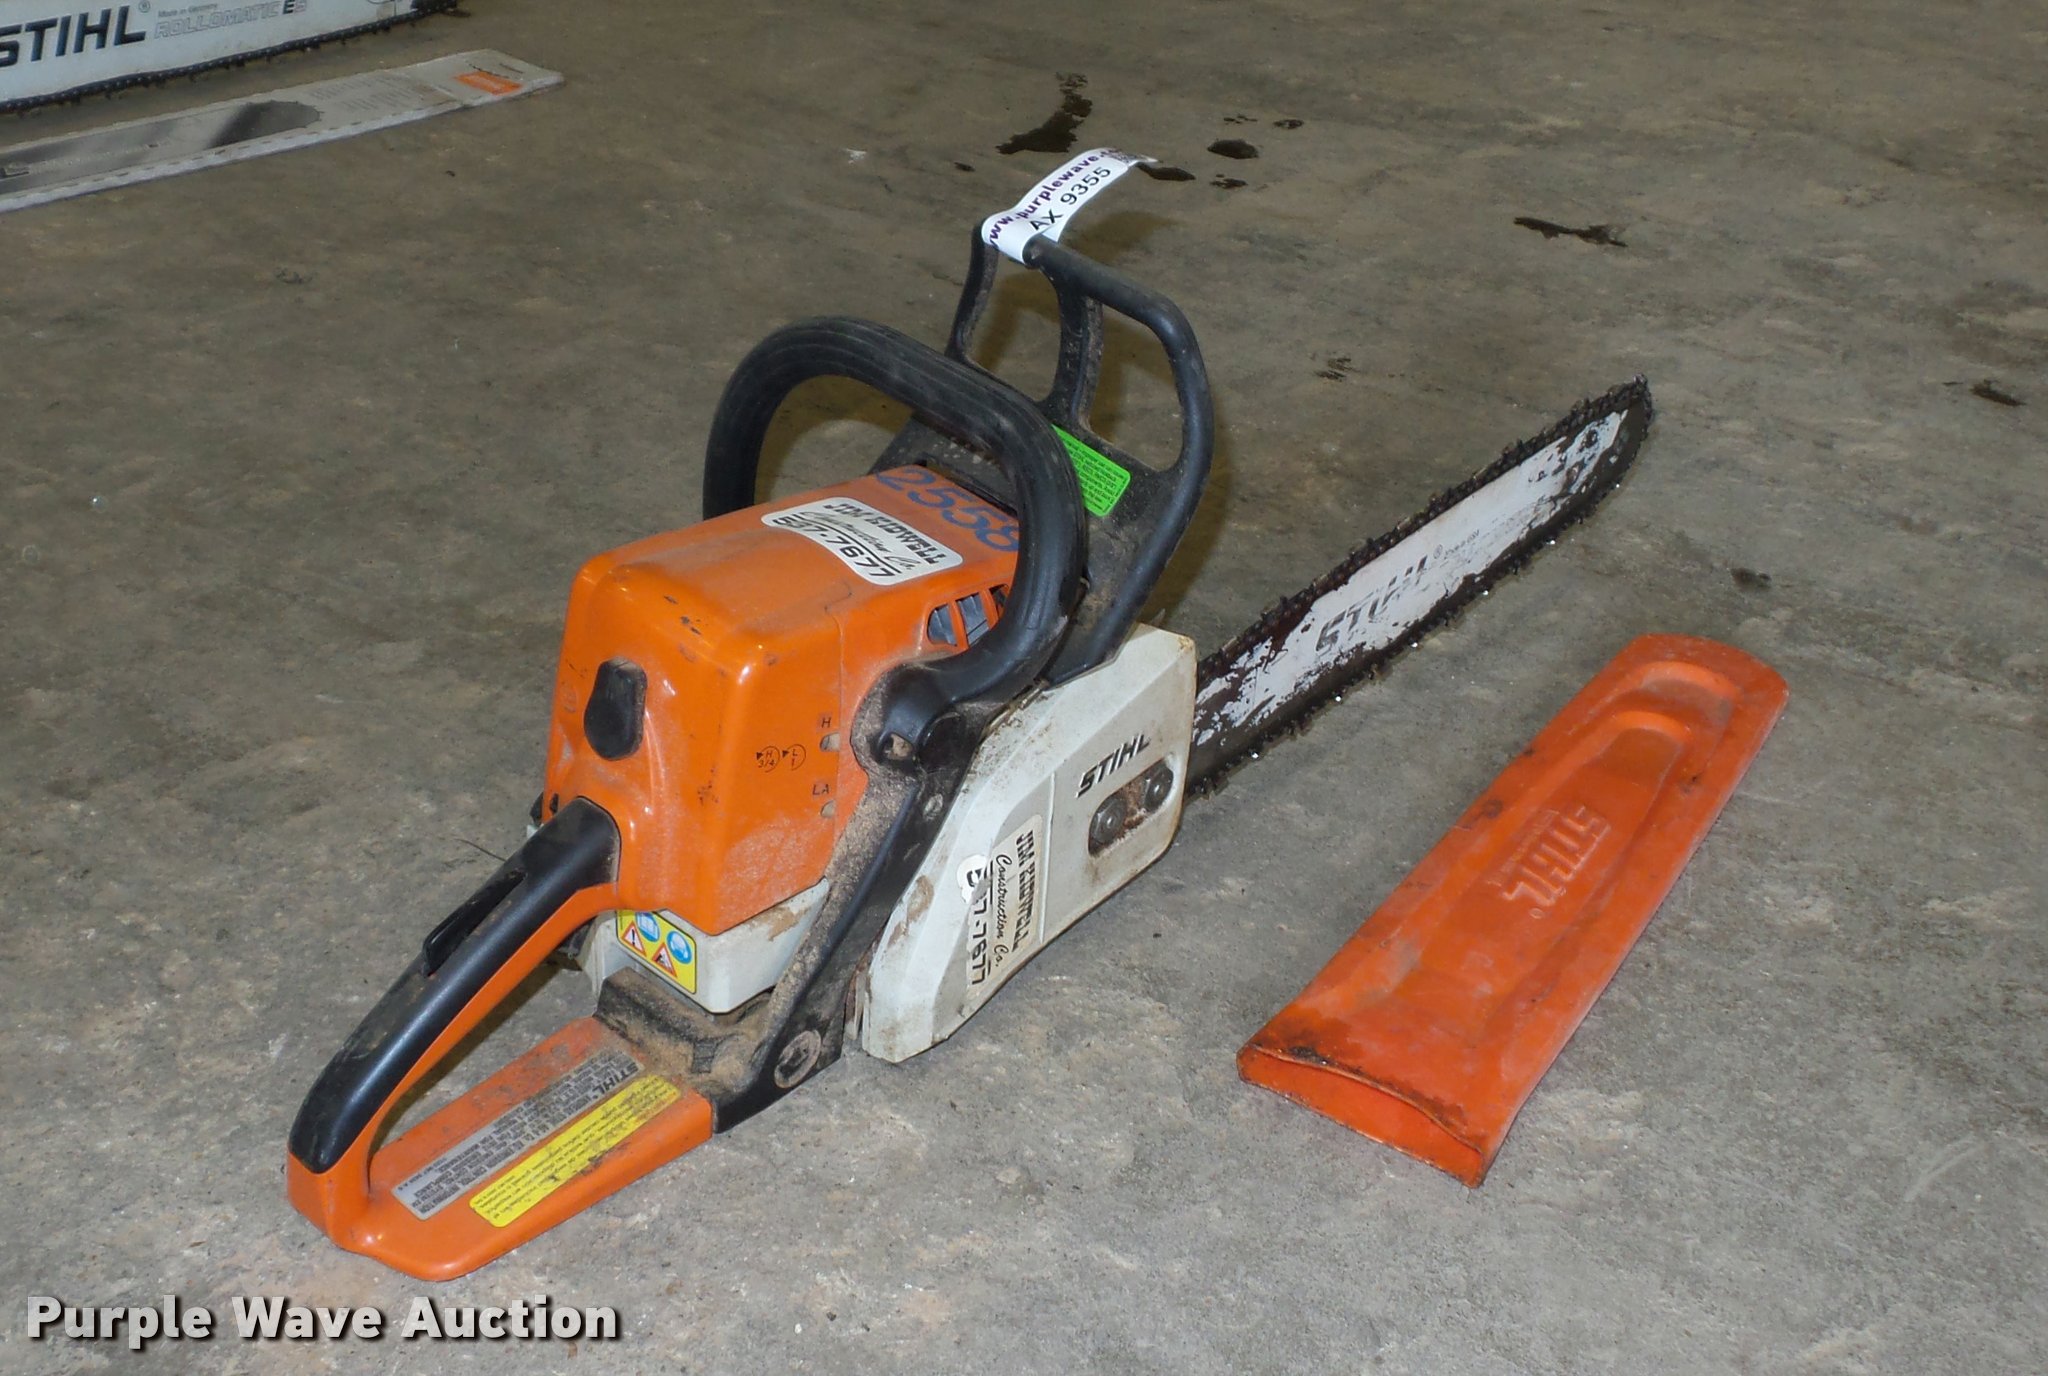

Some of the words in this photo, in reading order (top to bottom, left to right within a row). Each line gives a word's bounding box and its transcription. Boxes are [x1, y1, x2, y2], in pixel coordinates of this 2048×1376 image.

[0, 5, 147, 68] STIHL
[154, 1, 281, 39] ROLLOMATIC
[1030, 210, 1064, 231] AX
[1060, 167, 1111, 205] 9355
[823, 503, 873, 518] JIM
[865, 515, 947, 564] KIDWELL
[876, 468, 1019, 552] 2558
[1075, 734, 1149, 798] STIHL
[1016, 829, 1035, 867] JIM
[1487, 806, 1612, 906] STIHL
[996, 854, 1012, 939] Construction
[1012, 861, 1036, 952] KIDWELL
[994, 944, 1009, 967] Co.
[591, 1062, 642, 1096] STIHL
